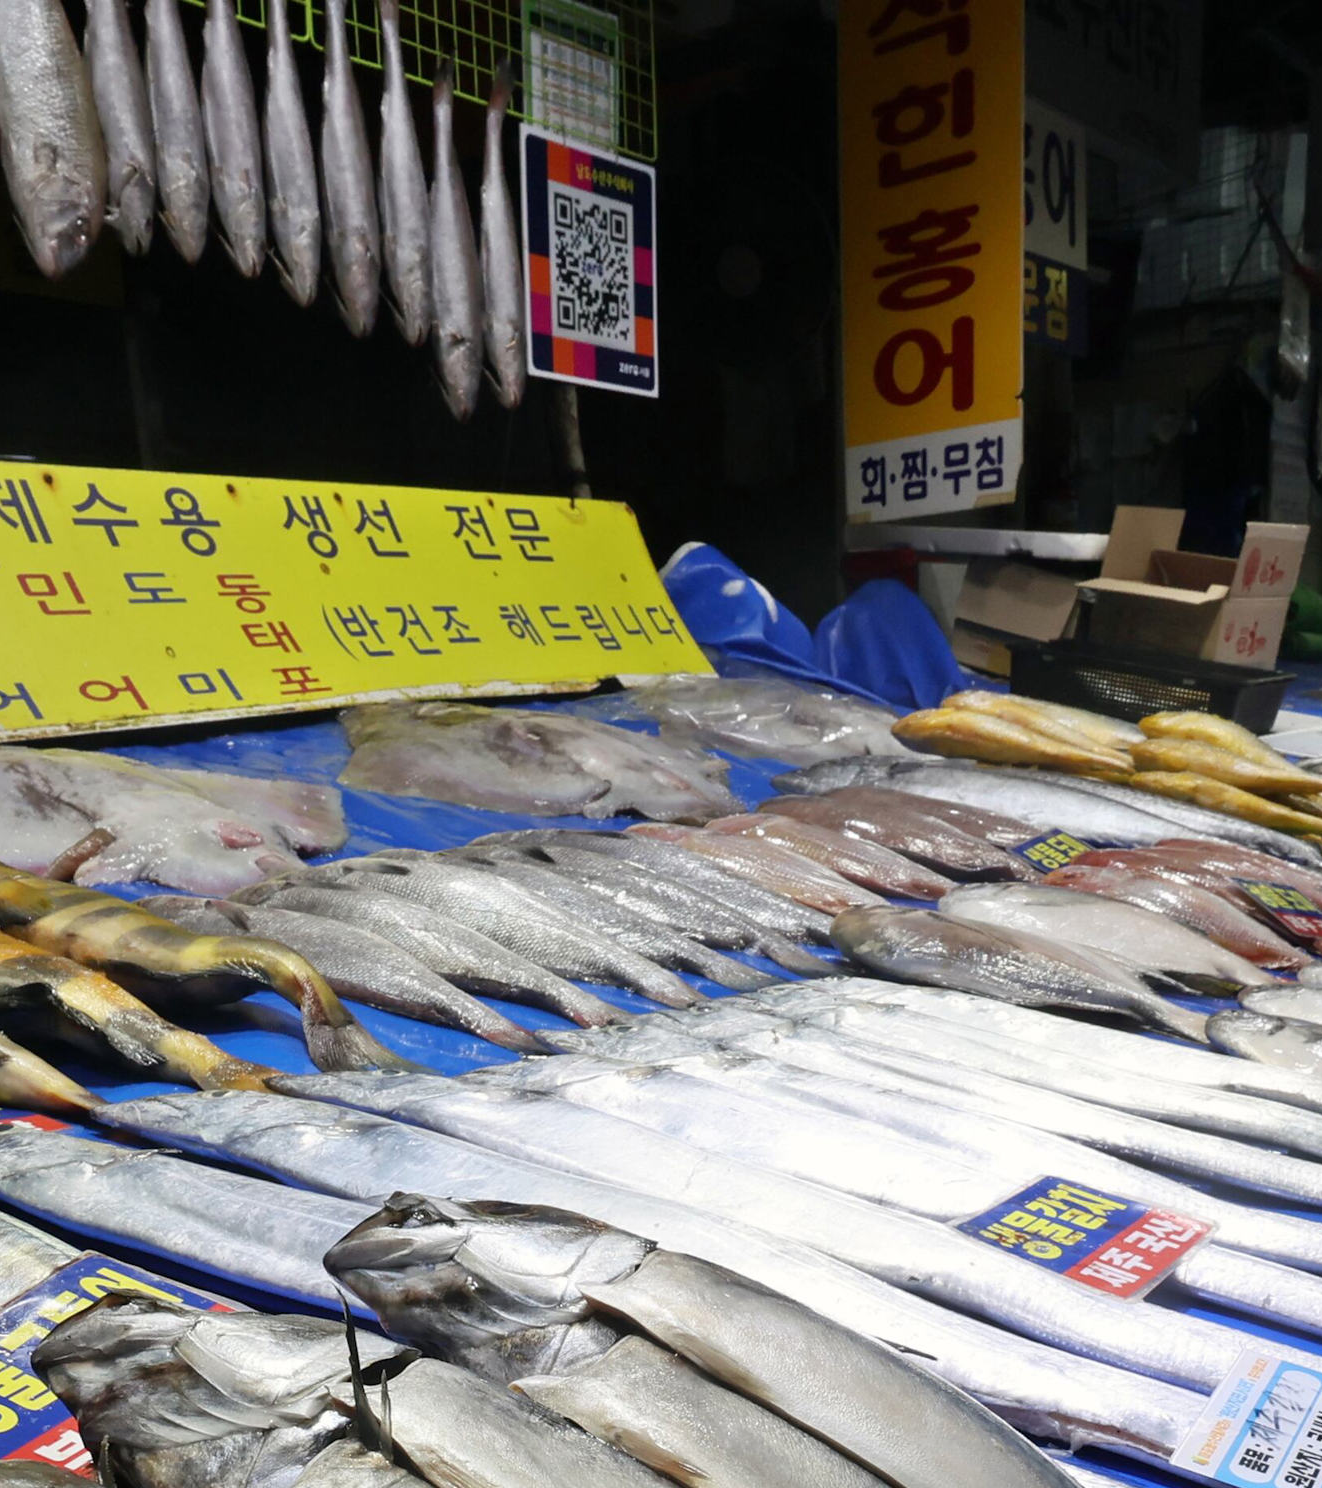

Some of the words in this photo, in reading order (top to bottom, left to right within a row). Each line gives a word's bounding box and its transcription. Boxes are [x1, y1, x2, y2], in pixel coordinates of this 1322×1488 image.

[283, 493, 410, 559] 생선
[450, 504, 554, 563] 전문
[504, 602, 680, 657] 해드립니다
